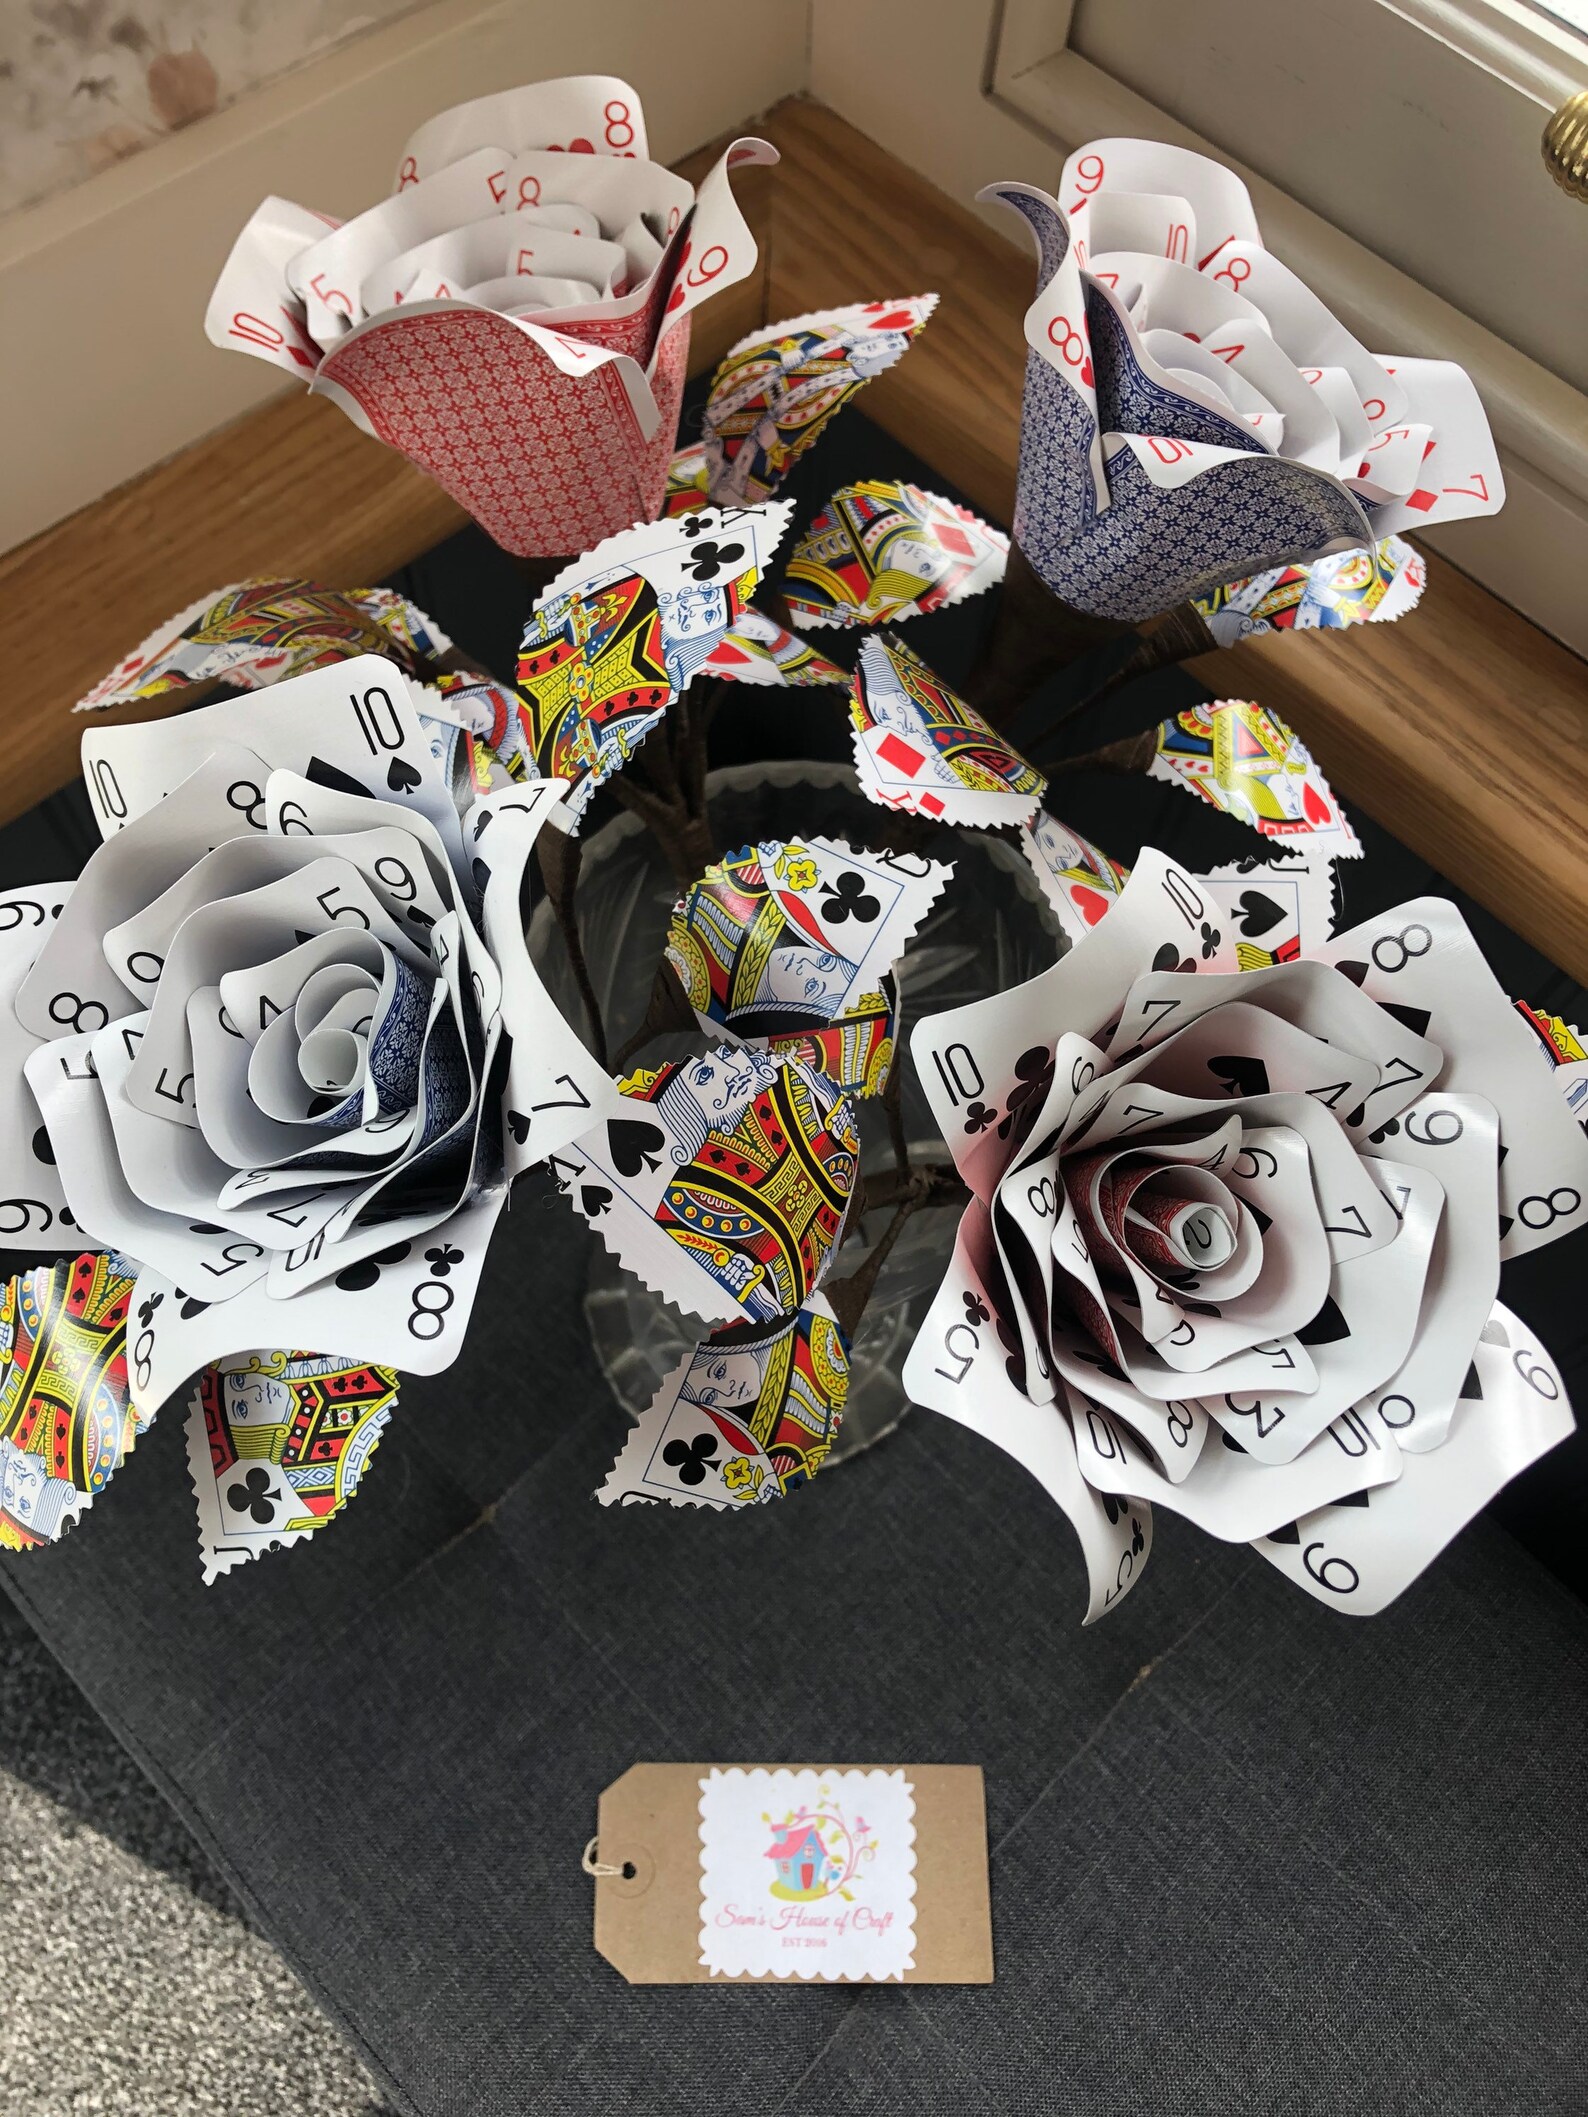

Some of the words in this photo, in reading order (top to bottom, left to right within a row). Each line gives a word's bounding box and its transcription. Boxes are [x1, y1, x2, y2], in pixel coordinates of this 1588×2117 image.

[605, 101, 634, 148] 8
[1075, 155, 1104, 194] 9
[228, 312, 285, 353] 10
[1047, 316, 1085, 366] 8
[1443, 473, 1489, 502] 7
[350, 686, 405, 756] 10
[88, 758, 128, 819] 10
[316, 886, 371, 931] 5
[1160, 868, 1204, 931] 10
[1371, 923, 1433, 974] 8
[1136, 999, 1181, 1043] 7
[531, 1074, 592, 1112] 7
[931, 1043, 985, 1108] 10
[1116, 1104, 1164, 1135] 7
[266, 1192, 327, 1229] 7
[1324, 1205, 1373, 1239] 7
[1517, 1186, 1582, 1230] 8
[200, 1242, 265, 1277] 5
[407, 1281, 455, 1341] 8
[134, 1328, 155, 1392] 8
[934, 1323, 980, 1385] 5
[715, 1904, 766, 1929] Sam's
[770, 1905, 830, 1931] House
[833, 1910, 850, 1936] of
[852, 1906, 895, 1937] Craft
[782, 1936, 802, 1948] EST
